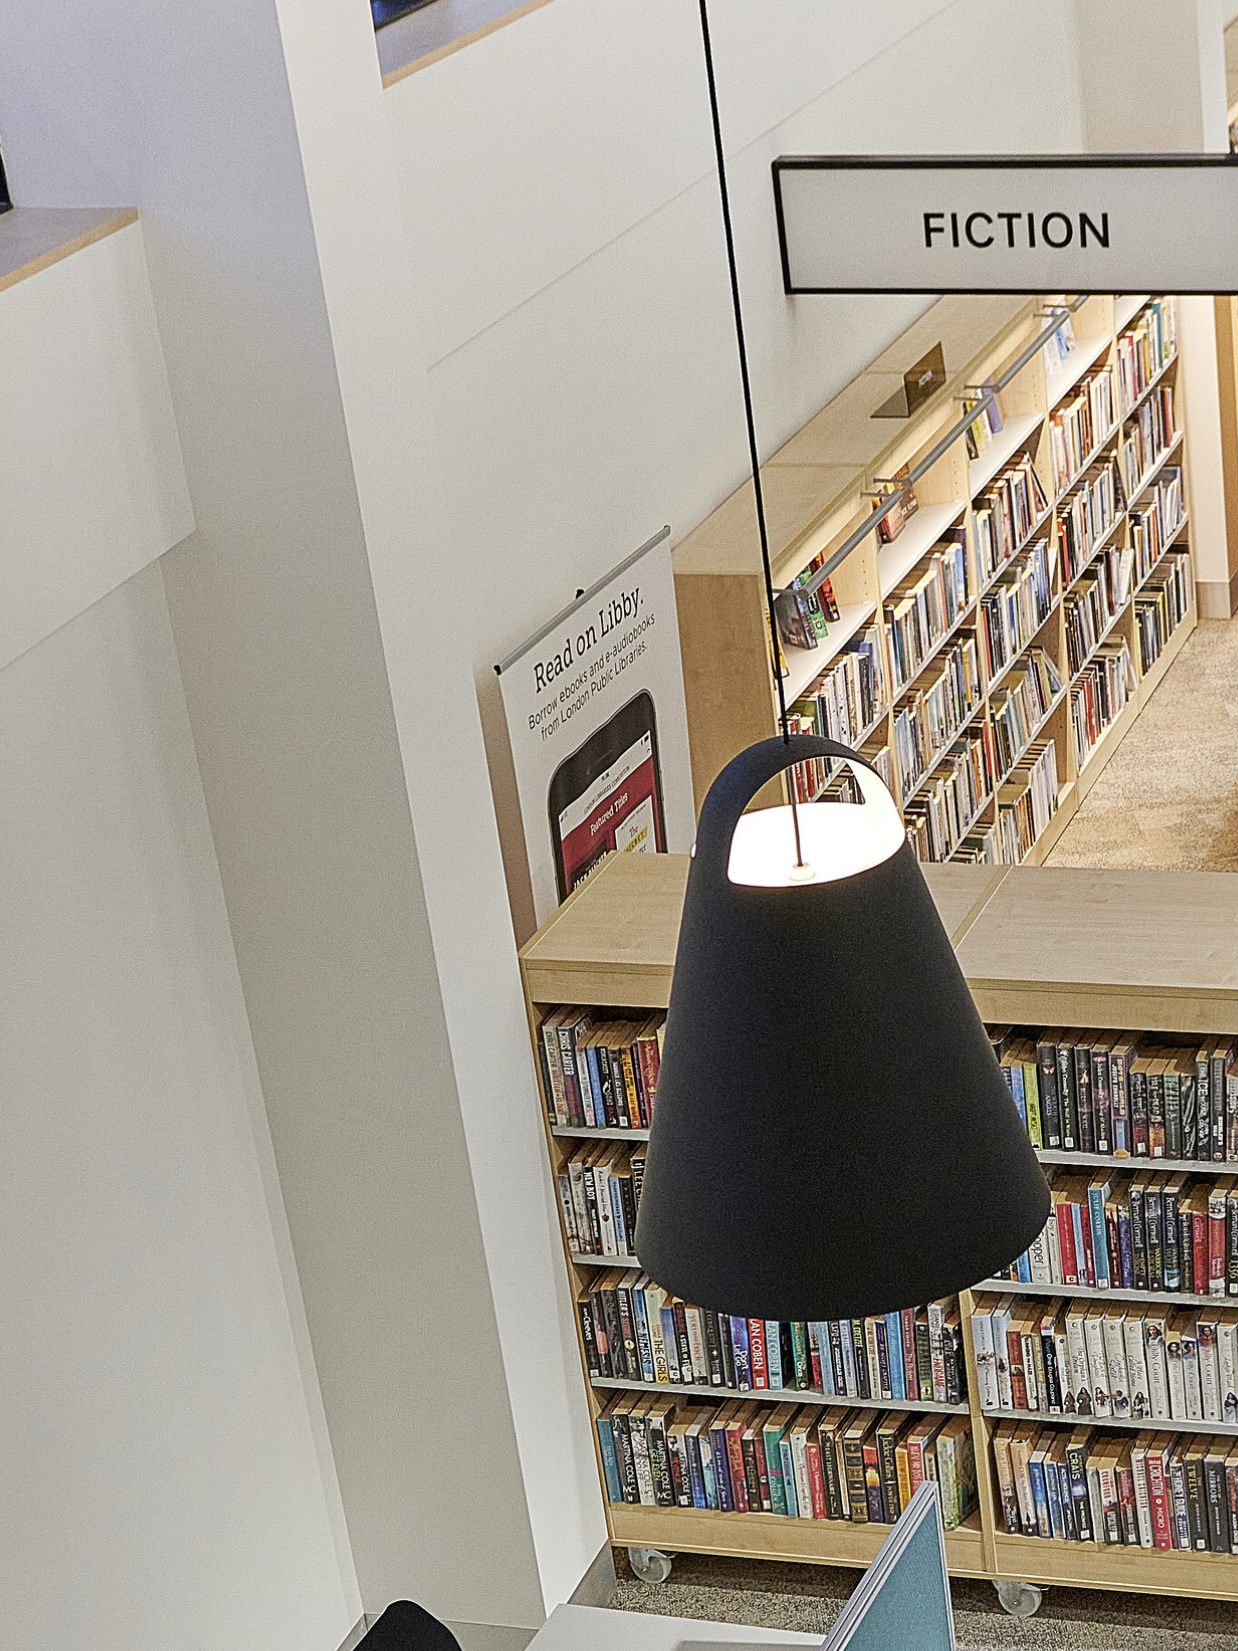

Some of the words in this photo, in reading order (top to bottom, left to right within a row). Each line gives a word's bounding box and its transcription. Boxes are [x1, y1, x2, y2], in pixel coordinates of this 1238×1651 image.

[922, 211, 1110, 249] FICTION
[533, 639, 573, 694] Read
[576, 625, 597, 656] on
[599, 588, 644, 638] Libby.
[528, 695, 558, 730] Borrow
[559, 670, 587, 703] ebooks
[589, 655, 604, 680] and
[605, 613, 655, 663] e-audiobooks
[541, 717, 560, 740] from
[561, 692, 589, 723] London
[591, 670, 613, 696] Public
[614, 639, 647, 676] Libraries.
[590, 806, 614, 836] Featured
[614, 792, 628, 811] Titles
[546, 1031, 555, 1046] CHRIS
[560, 1032, 570, 1050] CHRIS
[549, 1048, 557, 1067] CARTER
[562, 1052, 574, 1075] CARTER
[584, 1172, 593, 1185] NEW
[587, 1187, 595, 1200] BOY
[1092, 1192, 1100, 1210] JULIE
[1133, 1201, 1141, 1222] Bernard
[1148, 1196, 1157, 1218] Bernard
[1166, 1197, 1175, 1219] Bernard
[1231, 1209, 1238, 1232] Bernard
[1133, 1224, 1143, 1248] Cornwell
[1149, 1220, 1158, 1244] Cornwell
[1166, 1221, 1175, 1243] Cornwell
[583, 1316, 592, 1341] Cleeves
[638, 1333, 652, 1365] NEMESIS
[654, 1339, 664, 1355] THE
[752, 1338, 763, 1369] COBEN
[769, 1342, 779, 1371] COBEN
[655, 1357, 667, 1382] GIRLS
[735, 1356, 741, 1366] Go
[740, 1350, 748, 1370] Don't
[933, 1358, 944, 1388] ENDGAME
[1152, 1363, 1160, 1384] Court
[638, 1439, 650, 1469] MARTINA
[650, 1449, 658, 1463] GET
[656, 1440, 667, 1468] MARTINA
[880, 1436, 891, 1456] Jackie
[621, 1434, 631, 1464] MARTINA
[626, 1465, 634, 1484] COLE
[885, 1457, 893, 1478] Collins
[1069, 1452, 1080, 1480] CRAIS
[643, 1469, 651, 1488] COLE
[652, 1464, 661, 1481] EVEN
[661, 1469, 670, 1490] COLE
[1149, 1465, 1164, 1496] CRICHTON
[1188, 1465, 1198, 1500] TWELVE
[682, 1477, 690, 1493] COLE
[1174, 1478, 1183, 1498] HONEY
[1209, 1470, 1218, 1503] MIRRORS
[1156, 1507, 1165, 1528] MICRO
